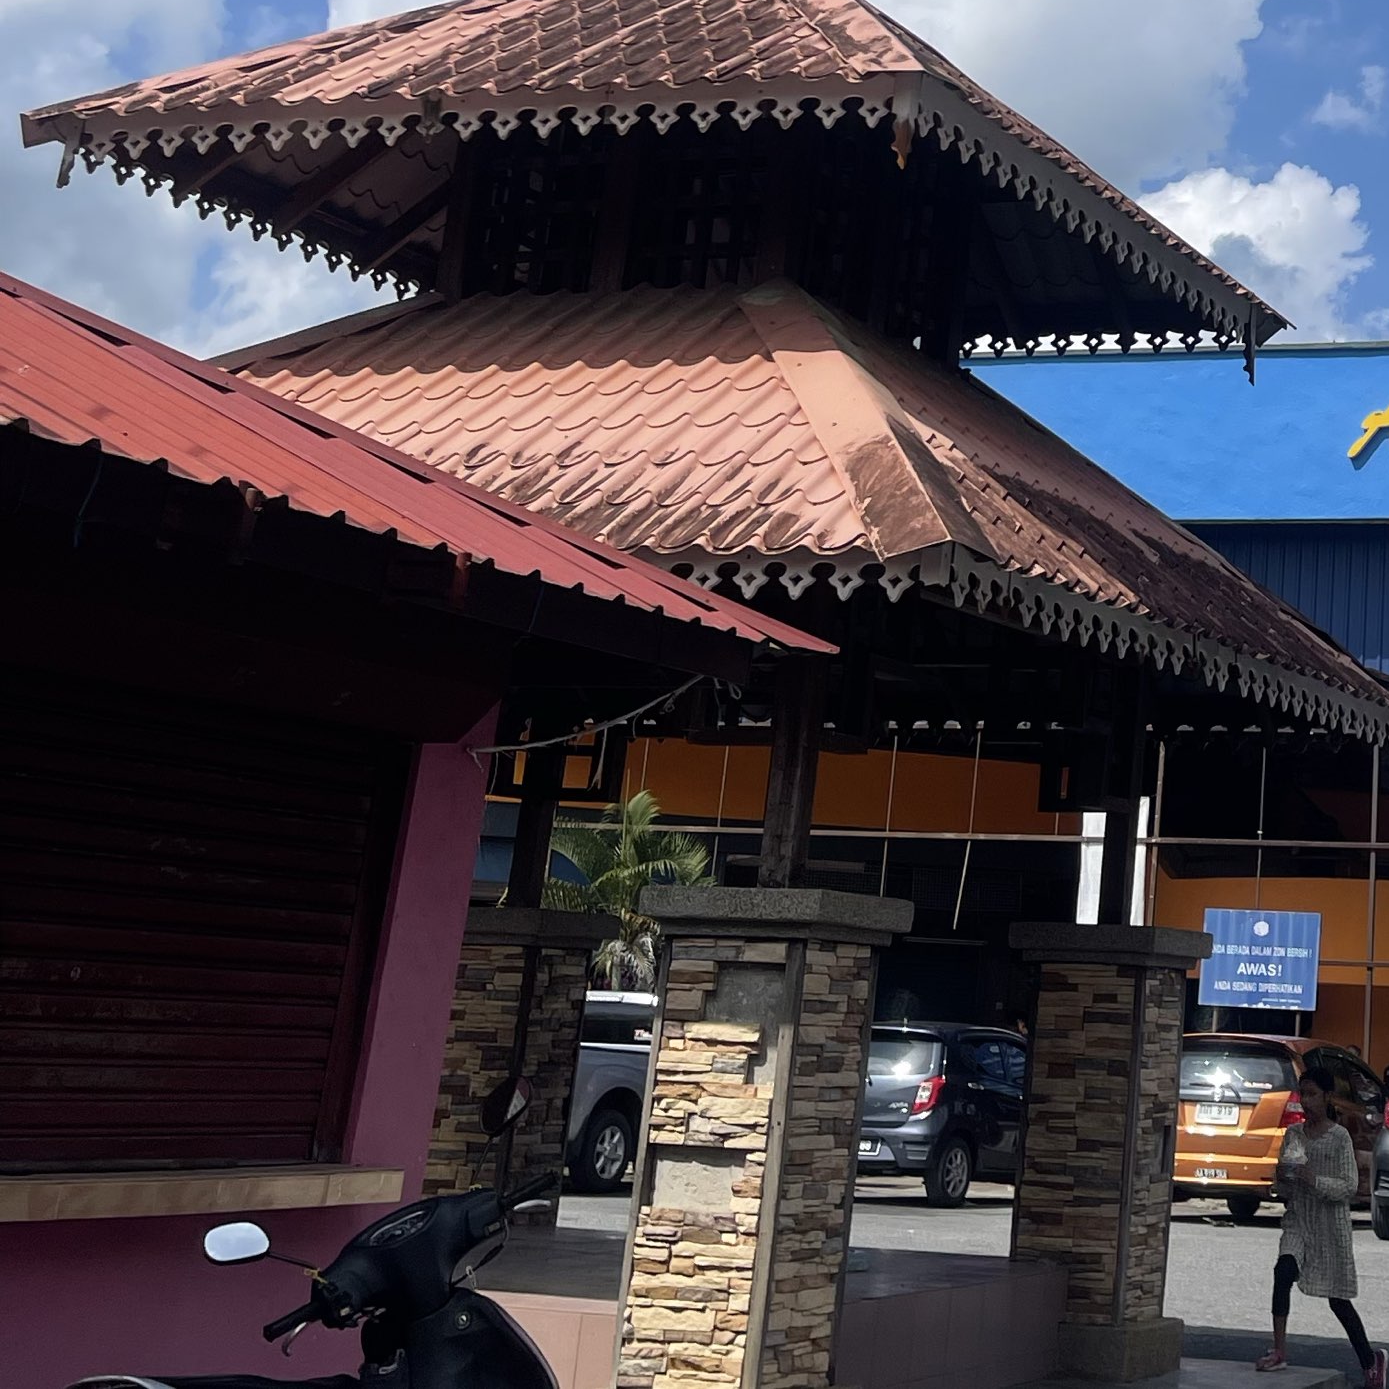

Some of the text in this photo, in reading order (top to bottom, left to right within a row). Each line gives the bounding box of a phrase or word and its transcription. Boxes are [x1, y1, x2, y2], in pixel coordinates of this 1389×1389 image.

[1251, 945, 1273, 957] DALAM
[1213, 980, 1303, 995] ANDA SEDANG DIPERHATIKAN
